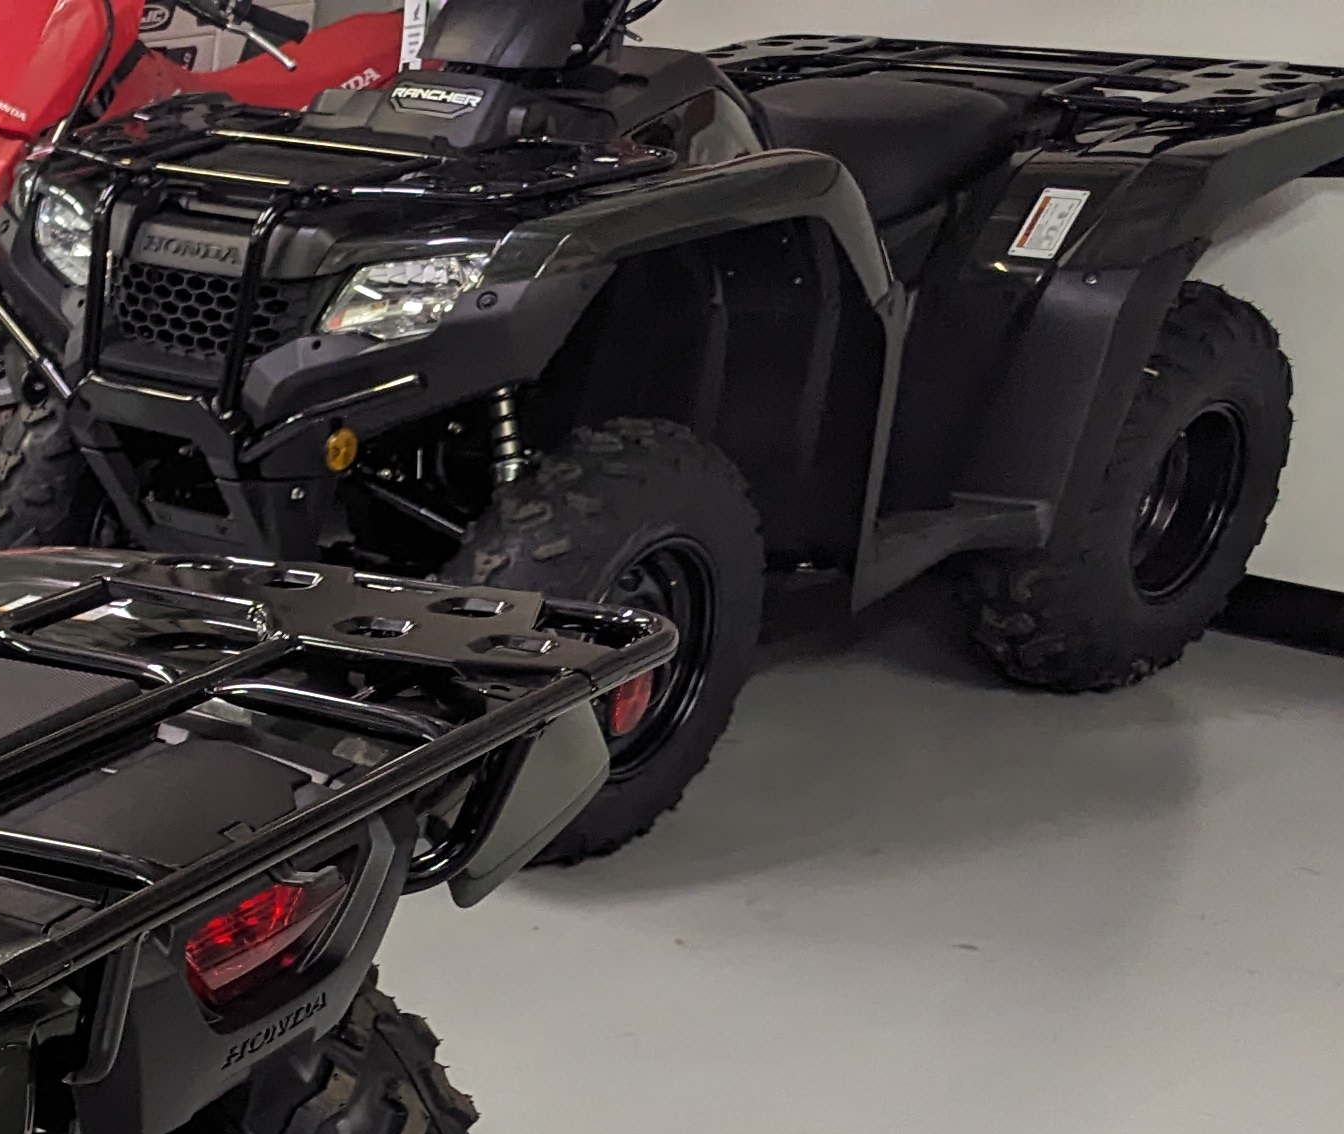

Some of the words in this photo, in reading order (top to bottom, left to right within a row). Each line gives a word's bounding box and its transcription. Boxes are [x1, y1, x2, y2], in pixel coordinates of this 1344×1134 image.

[391, 87, 483, 107] RANCHER
[142, 235, 242, 265] HONDA
[221, 992, 327, 1070] HONDA
